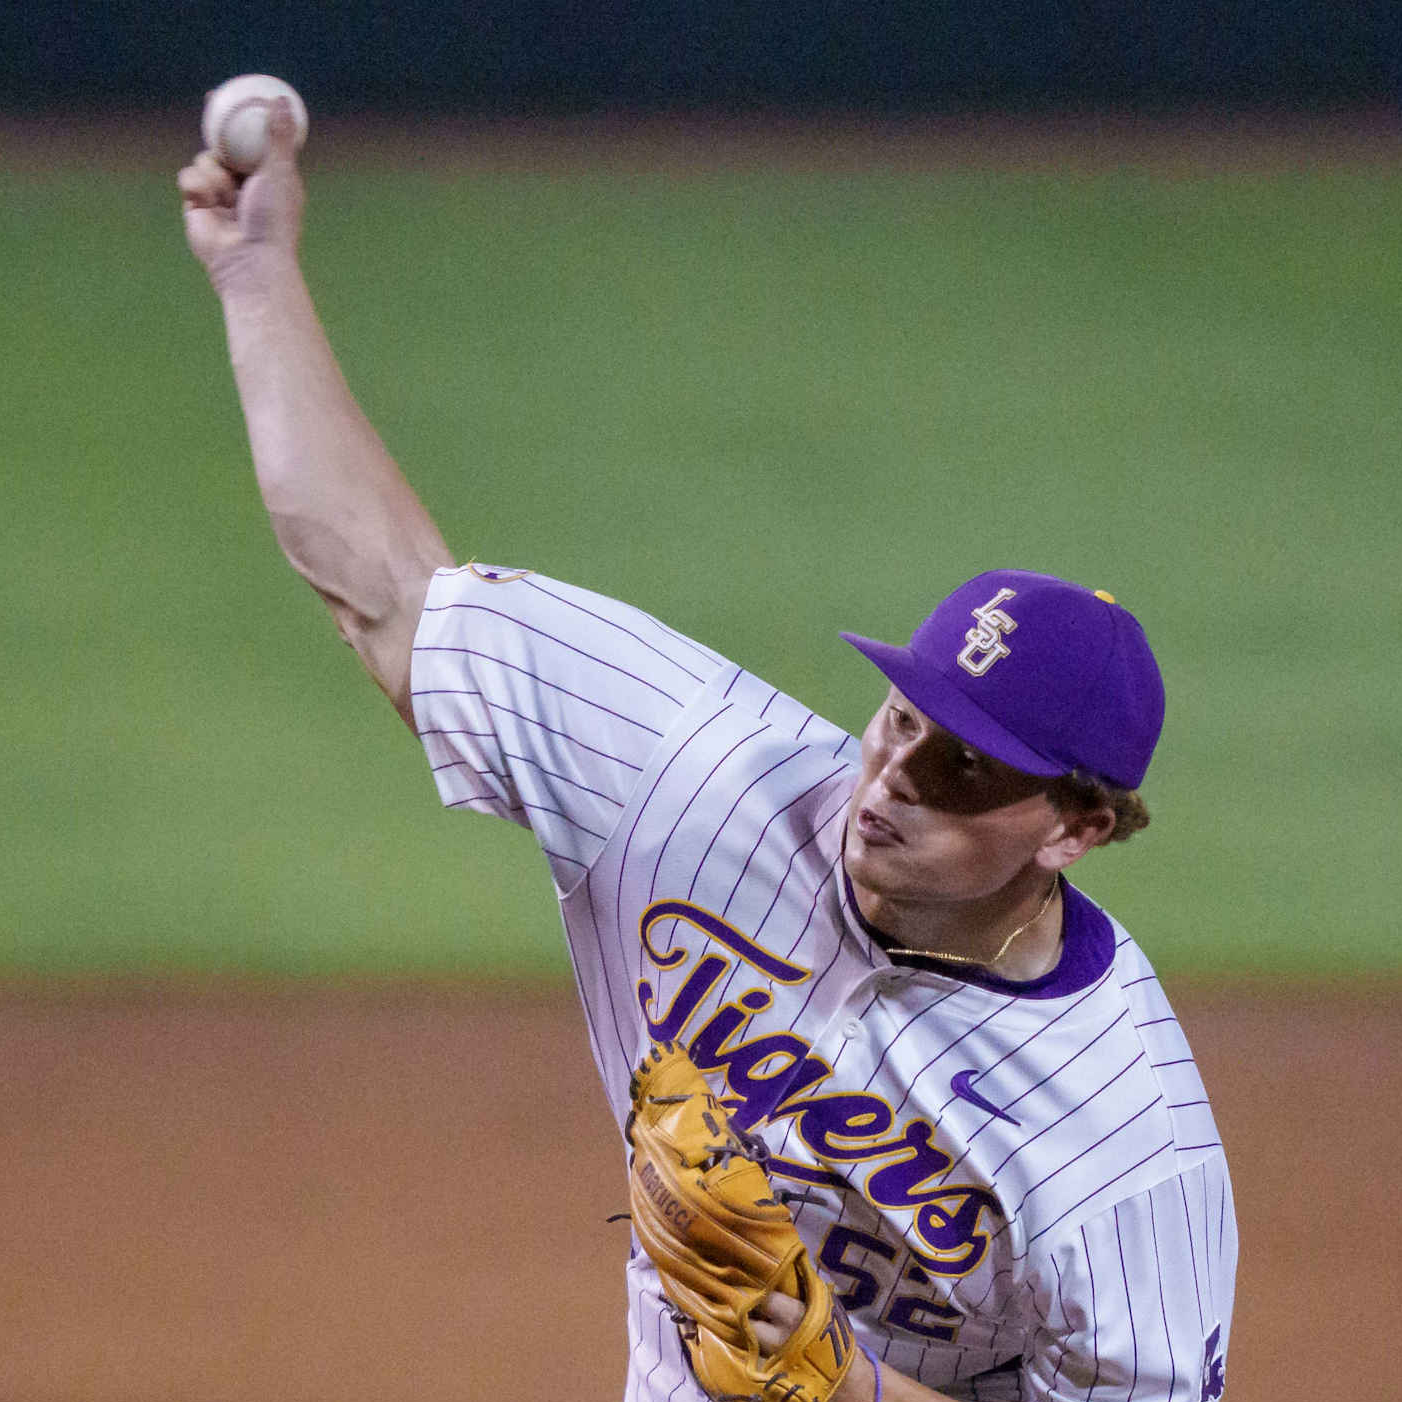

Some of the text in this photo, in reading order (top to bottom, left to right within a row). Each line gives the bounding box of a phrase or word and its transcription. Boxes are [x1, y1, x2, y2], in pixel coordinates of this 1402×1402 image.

[957, 587, 1018, 677] LSU
[637, 898, 1000, 1278] Tigers
[817, 1223, 965, 1345] 52
